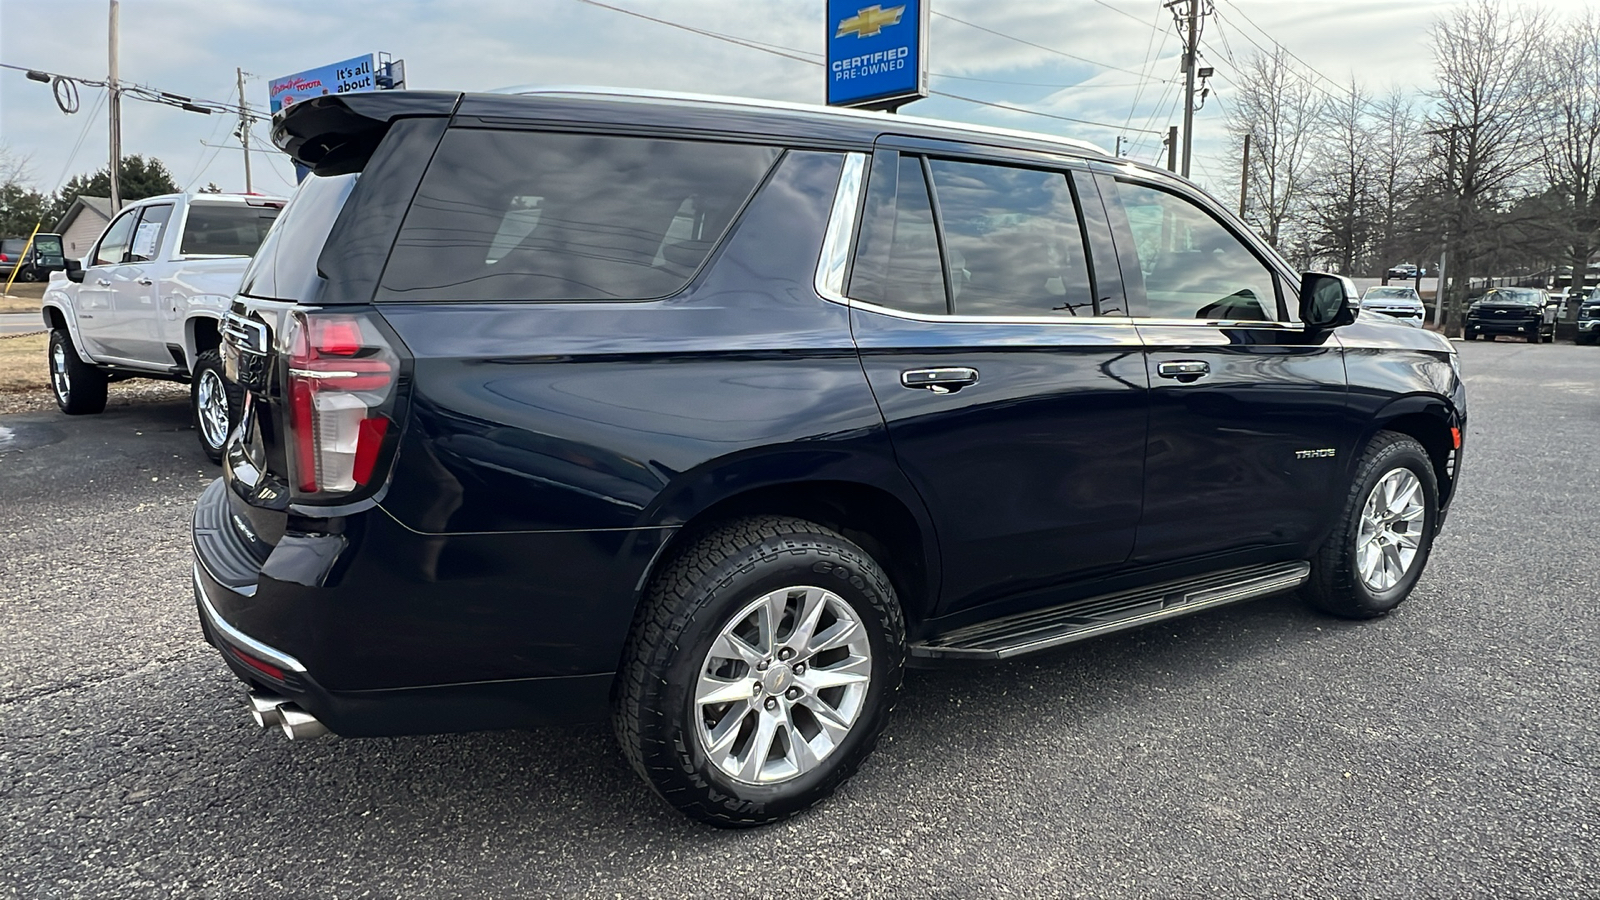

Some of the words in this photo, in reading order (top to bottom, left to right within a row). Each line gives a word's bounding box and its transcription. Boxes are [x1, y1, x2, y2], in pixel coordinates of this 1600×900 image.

[832, 46, 909, 72] CERTIFIED
[336, 67, 353, 81] It's
[355, 61, 370, 76] all
[835, 59, 905, 81] PRE-OWNED
[296, 80, 322, 92] TOYOTA
[337, 76, 371, 94] about
[1295, 448, 1336, 459] TAHOE
